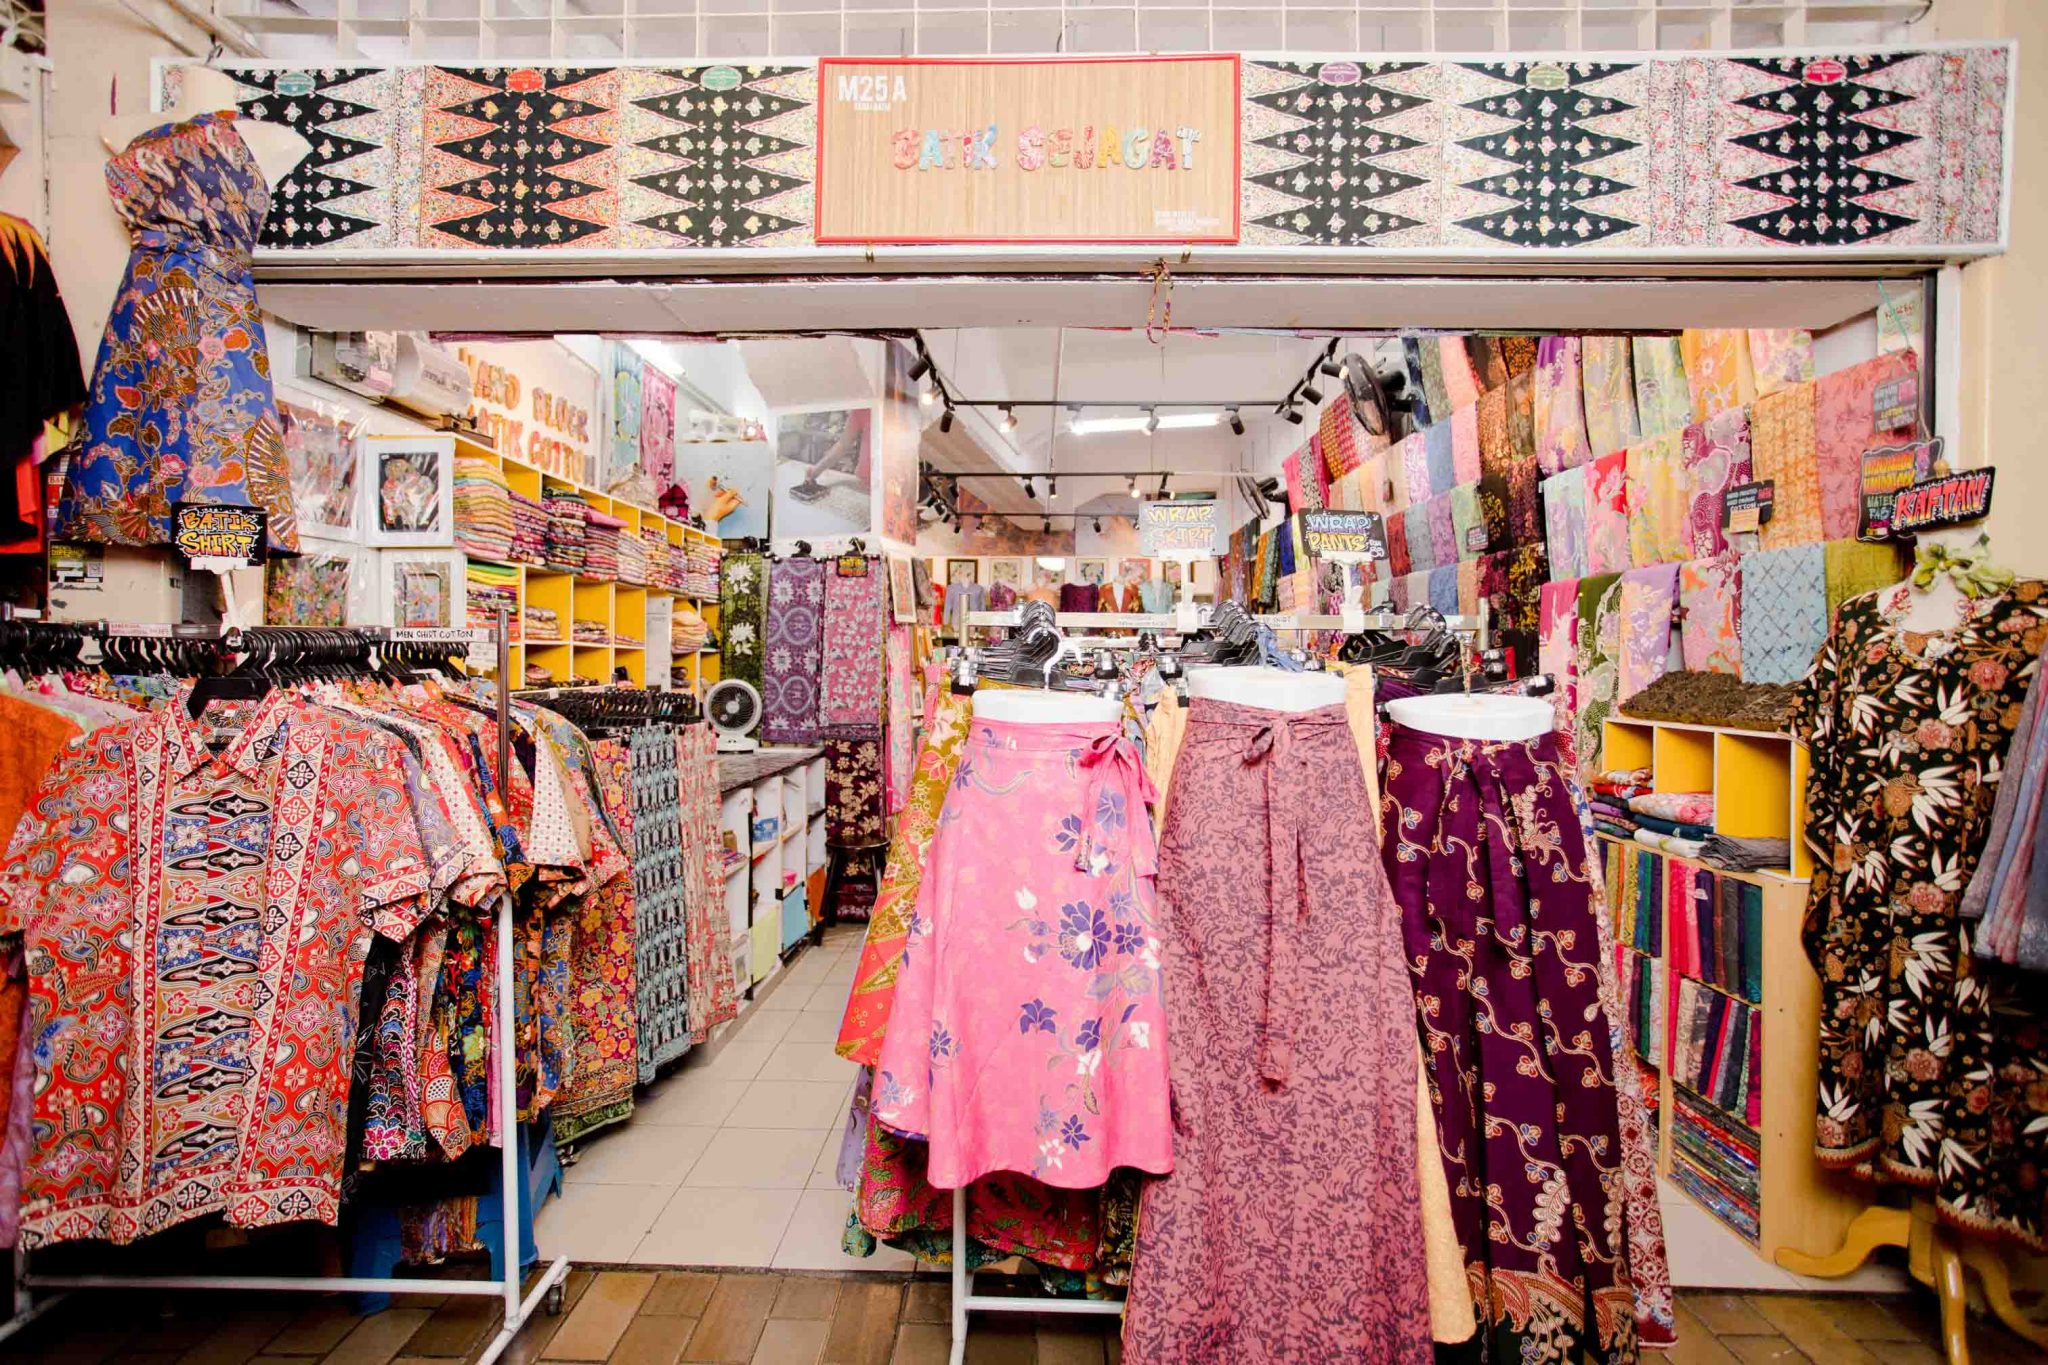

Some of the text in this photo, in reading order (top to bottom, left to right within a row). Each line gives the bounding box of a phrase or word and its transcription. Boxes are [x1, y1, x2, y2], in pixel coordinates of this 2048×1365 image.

[891, 124, 1202, 171] BATIK SEJAGAT
[467, 403, 523, 459] ATIK
[1893, 475, 1988, 528] KAFTAN
[181, 510, 258, 531] BATIK
[1147, 506, 1214, 523] WRAP
[1306, 515, 1371, 532] WRAP
[179, 531, 254, 557] SHIRT
[1151, 526, 1216, 548] SKIRT
[1307, 532, 1368, 552] PANTS
[396, 629, 474, 639] MEN SHIRT COTTON
